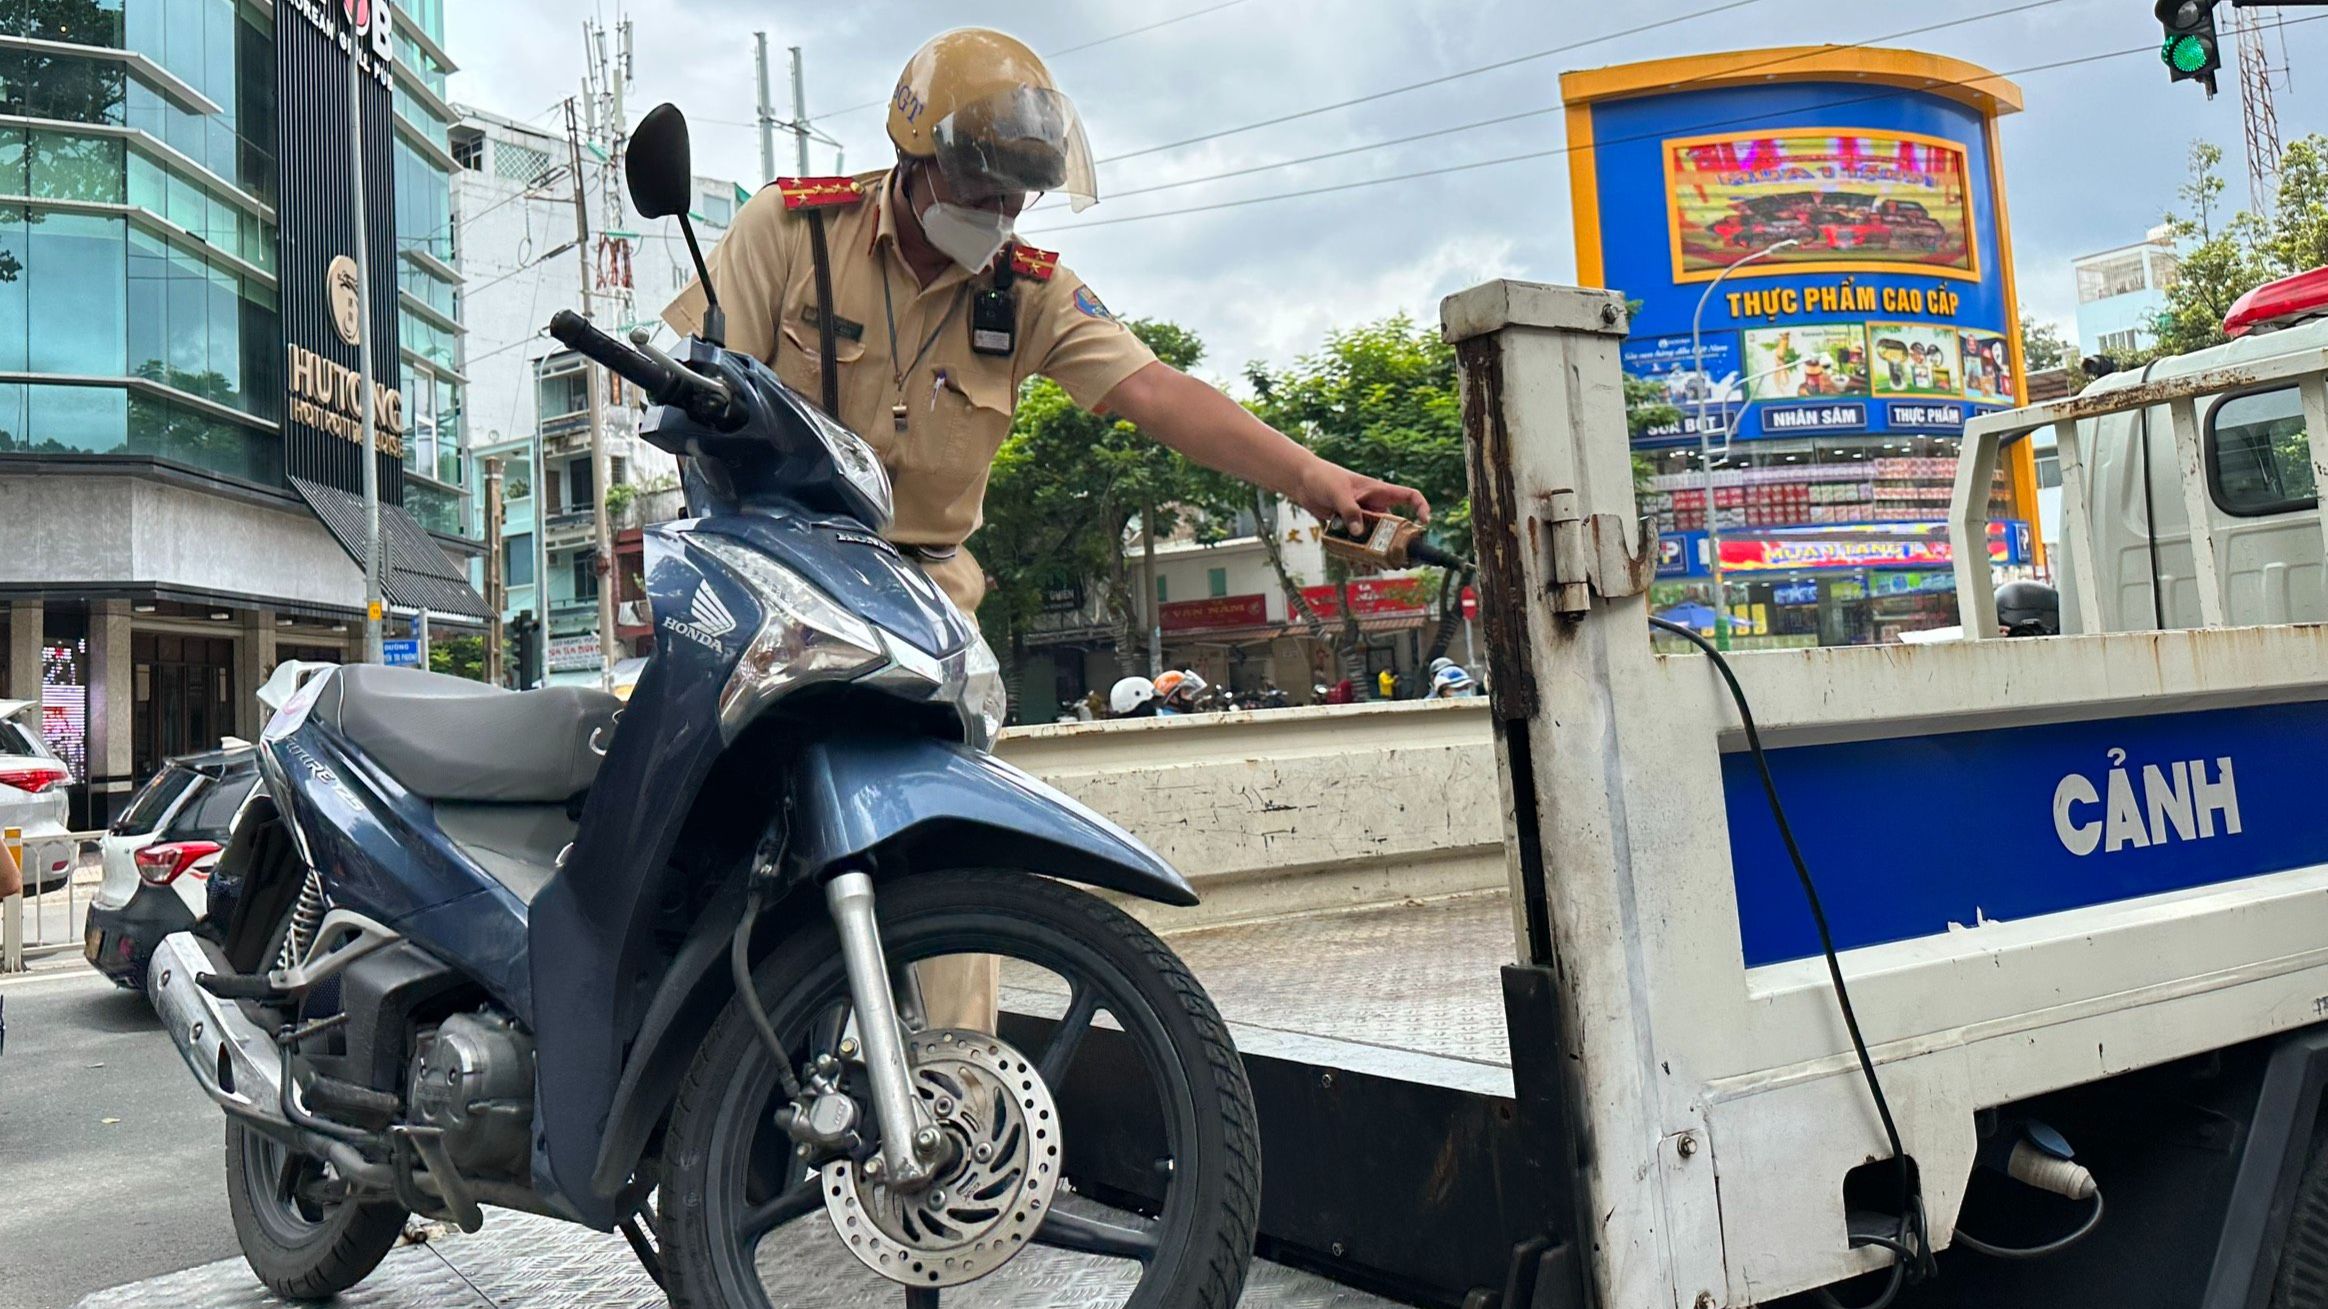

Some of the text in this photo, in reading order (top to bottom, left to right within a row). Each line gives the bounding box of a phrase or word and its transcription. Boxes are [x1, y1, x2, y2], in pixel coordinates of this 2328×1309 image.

[339, 31, 371, 73] GILL
[374, 61, 393, 92] PUB
[1727, 276, 1959, 321] THỰC PHẨM CAO CẤP
[288, 342, 403, 434] HUTONG
[1772, 406, 1857, 427] NHÂN SÂM
[1893, 407, 1925, 425] THỰC
[1927, 405, 1959, 424] PHẨM
[662, 616, 724, 655] HONDA
[2053, 747, 2242, 856] CẢNH
